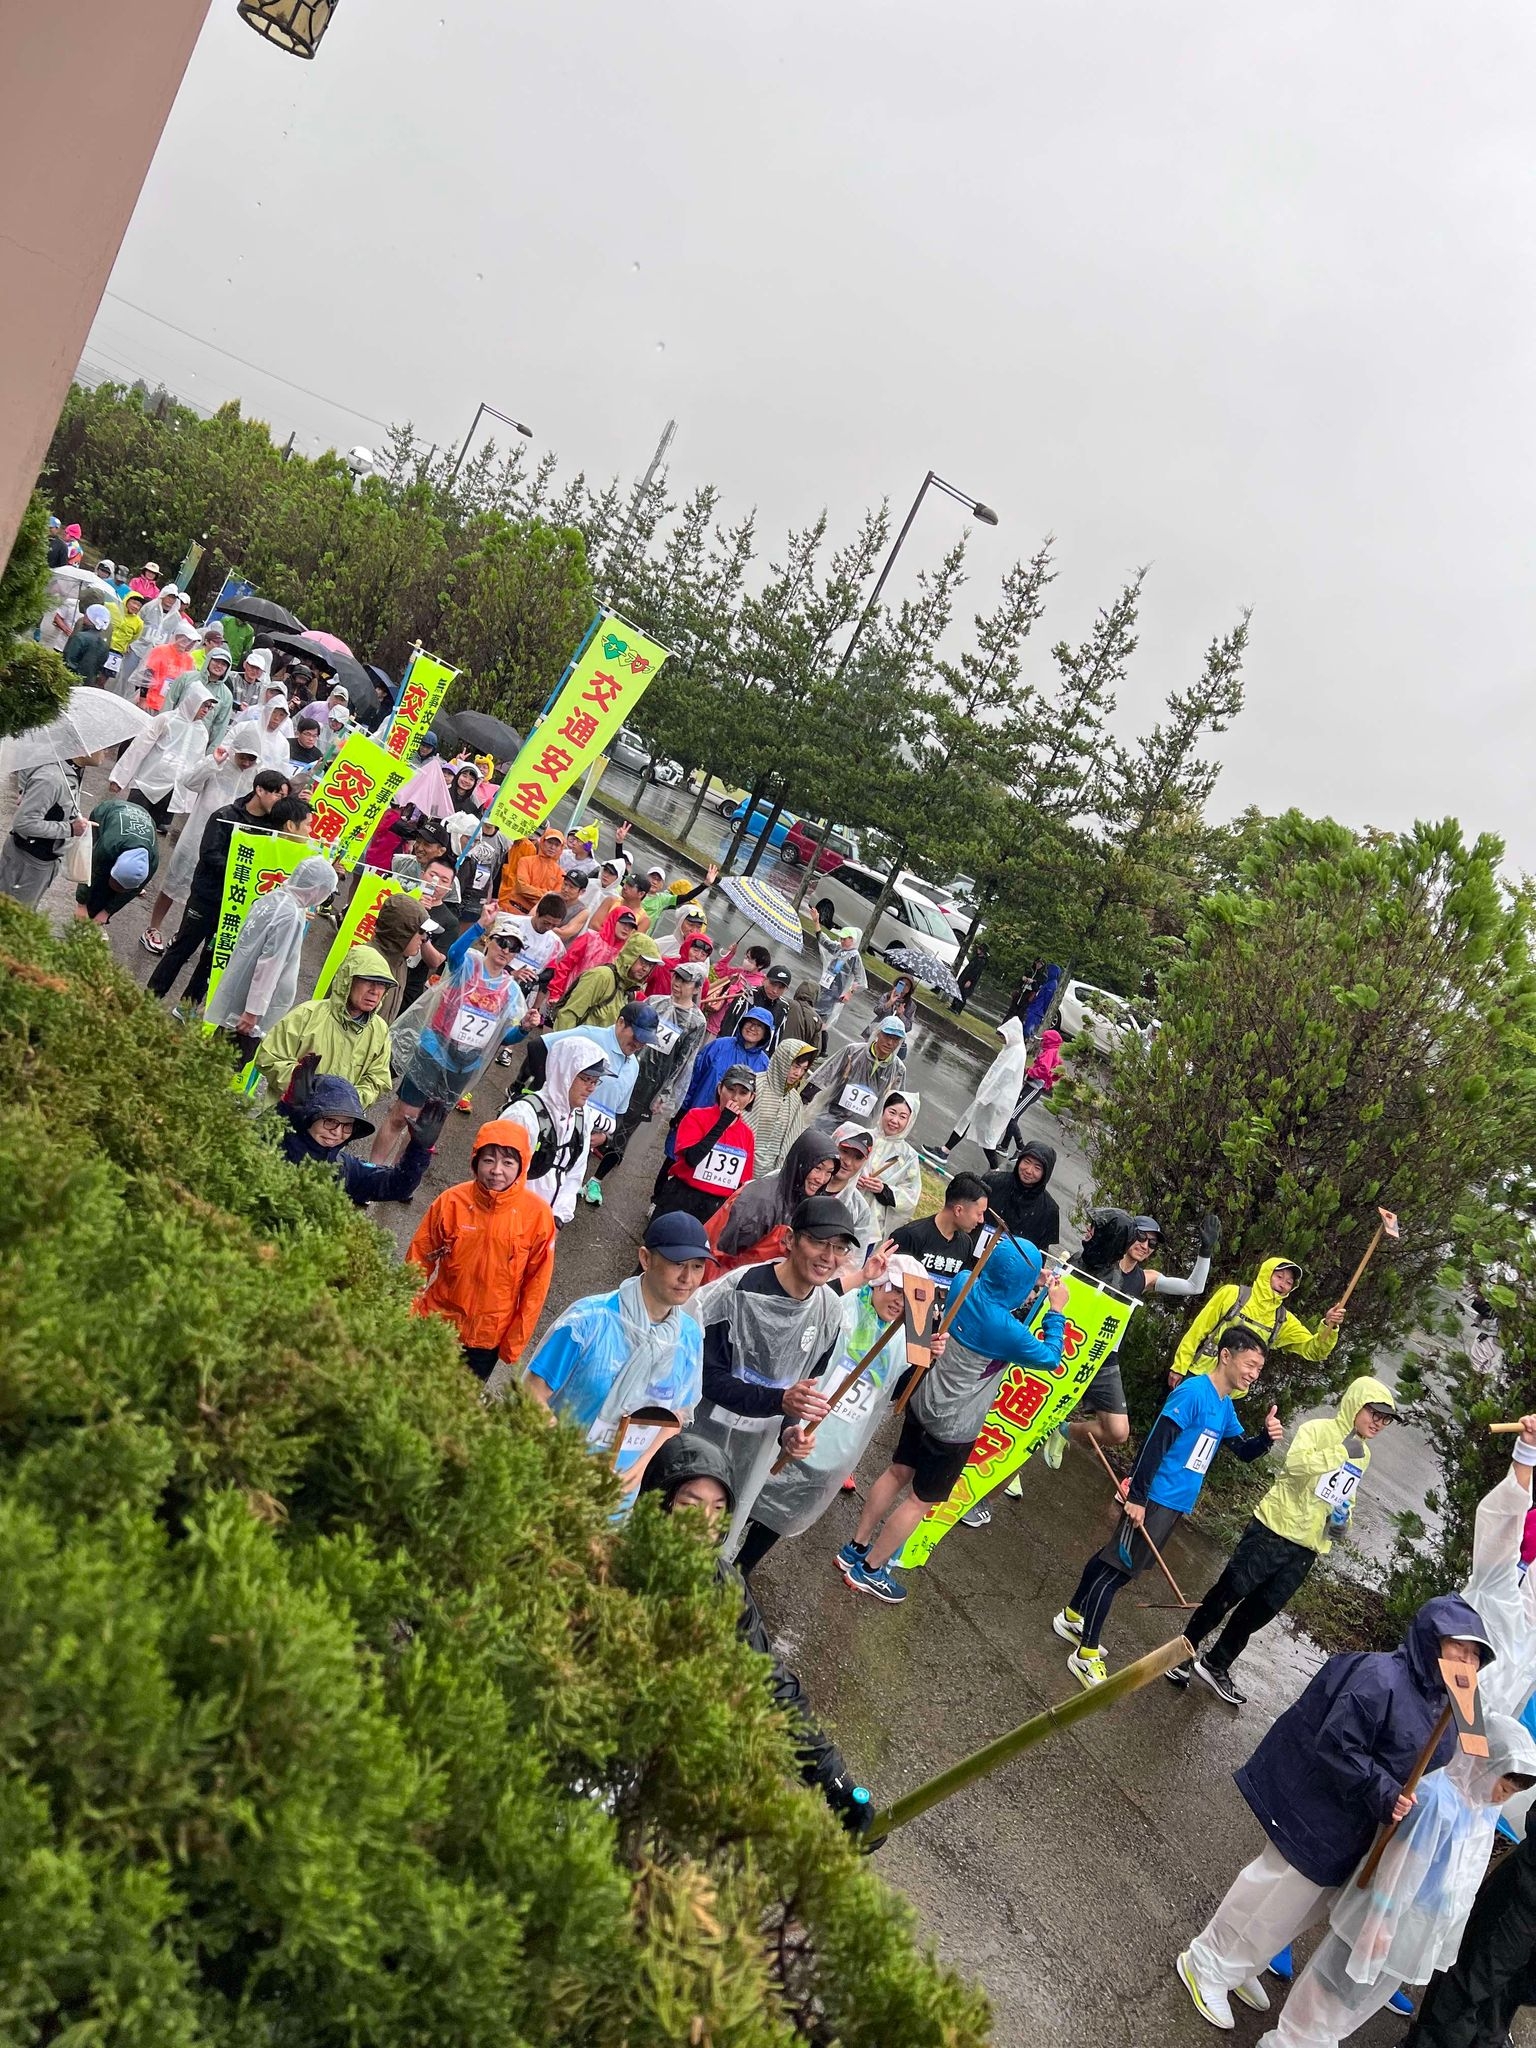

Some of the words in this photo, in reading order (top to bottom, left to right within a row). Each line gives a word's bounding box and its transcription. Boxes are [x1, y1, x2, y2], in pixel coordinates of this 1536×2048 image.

[509, 670, 623, 819] 交通安全
[462, 1015, 489, 1037] 22
[849, 1089, 870, 1106] 96
[705, 1151, 740, 1175] 139
[713, 1174, 732, 1185] PACO
